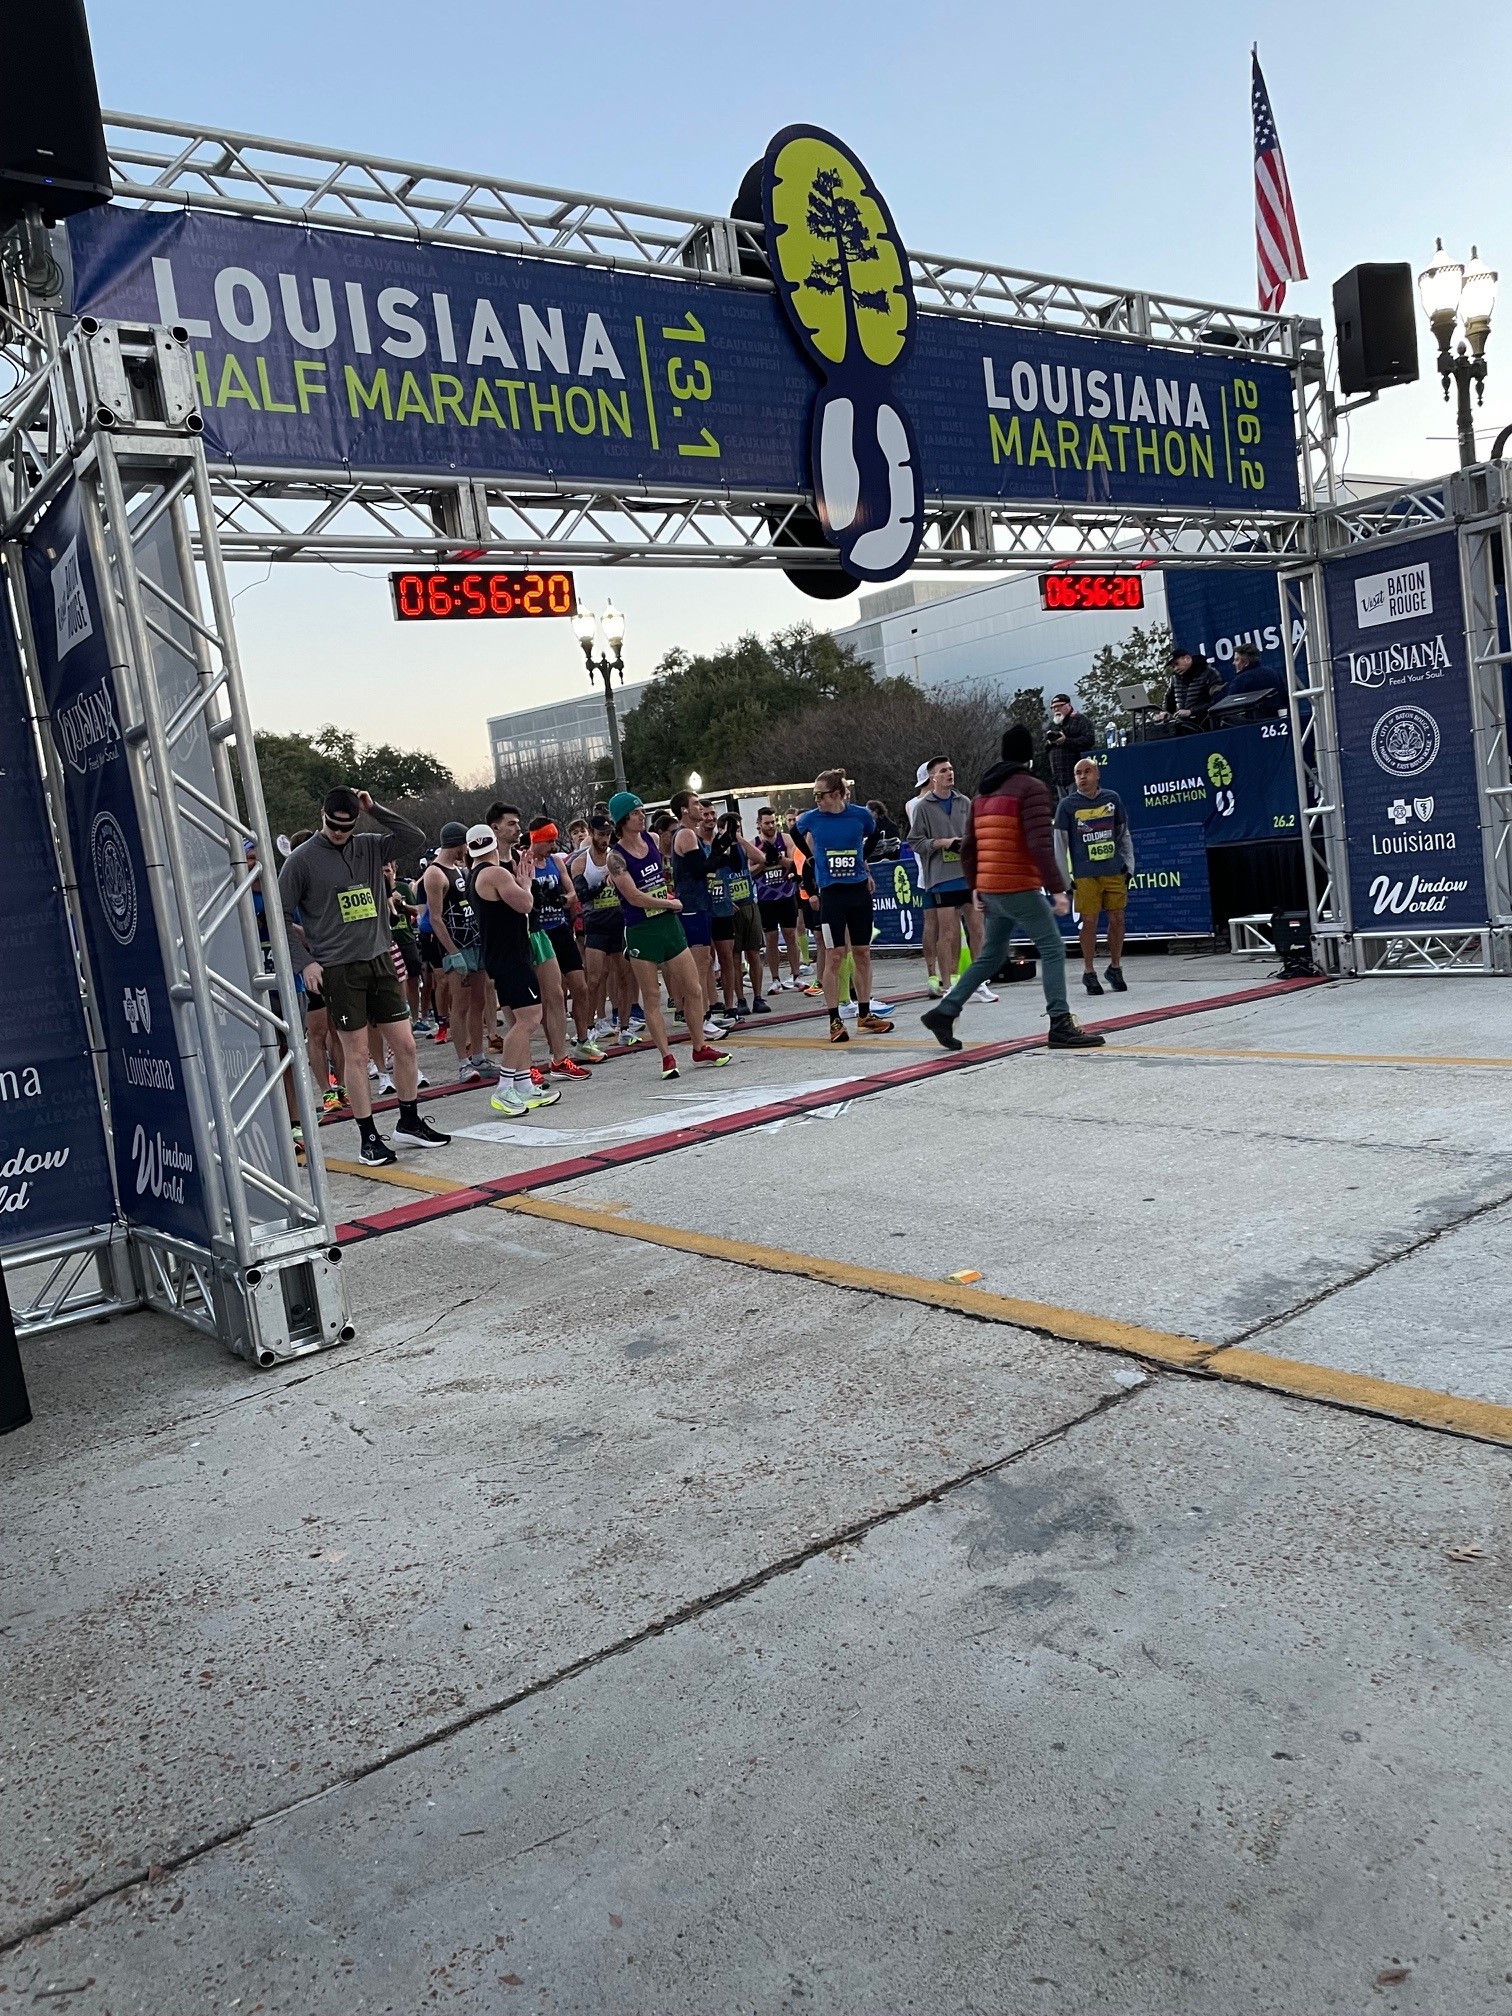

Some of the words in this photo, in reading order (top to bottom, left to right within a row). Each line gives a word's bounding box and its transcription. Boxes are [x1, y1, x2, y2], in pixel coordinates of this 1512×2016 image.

[151, 257, 626, 381] LOUISIANA
[662, 310, 721, 458] 13.1
[983, 356, 1210, 431] LOUISIANA
[344, 364, 633, 439] MARATHON
[988, 413, 1214, 480] MARATHON
[1233, 378, 1266, 491] 26.2
[399, 574, 571, 616] 06:56:20
[1046, 577, 1140, 607] 06:56:20
[1361, 590, 1385, 612] Visit
[1387, 570, 1426, 597] BATON
[1389, 591, 1427, 617] ROUGE
[1348, 633, 1453, 688] LOUISIANA
[1389, 676, 1407, 686] Feed
[1407, 673, 1424, 682] Your
[1261, 723, 1289, 738] 26.2
[1395, 712, 1415, 721] BATON
[1413, 715, 1430, 731] ROUGE
[1144, 777, 1205, 796] LOUISIANA
[1145, 789, 1207, 808] MARATHON
[1273, 815, 1295, 828] 26.2
[1091, 844, 1114, 856] 4689
[1372, 830, 1456, 855] Louisiana
[640, 862, 659, 877] LSU
[765, 869, 782, 879] 1507
[829, 857, 855, 868] 1963
[1128, 871, 1181, 890] ATHON
[342, 891, 373, 909] 3086
[1369, 875, 1468, 915] Window
[122, 1047, 175, 1091] Louisiana
